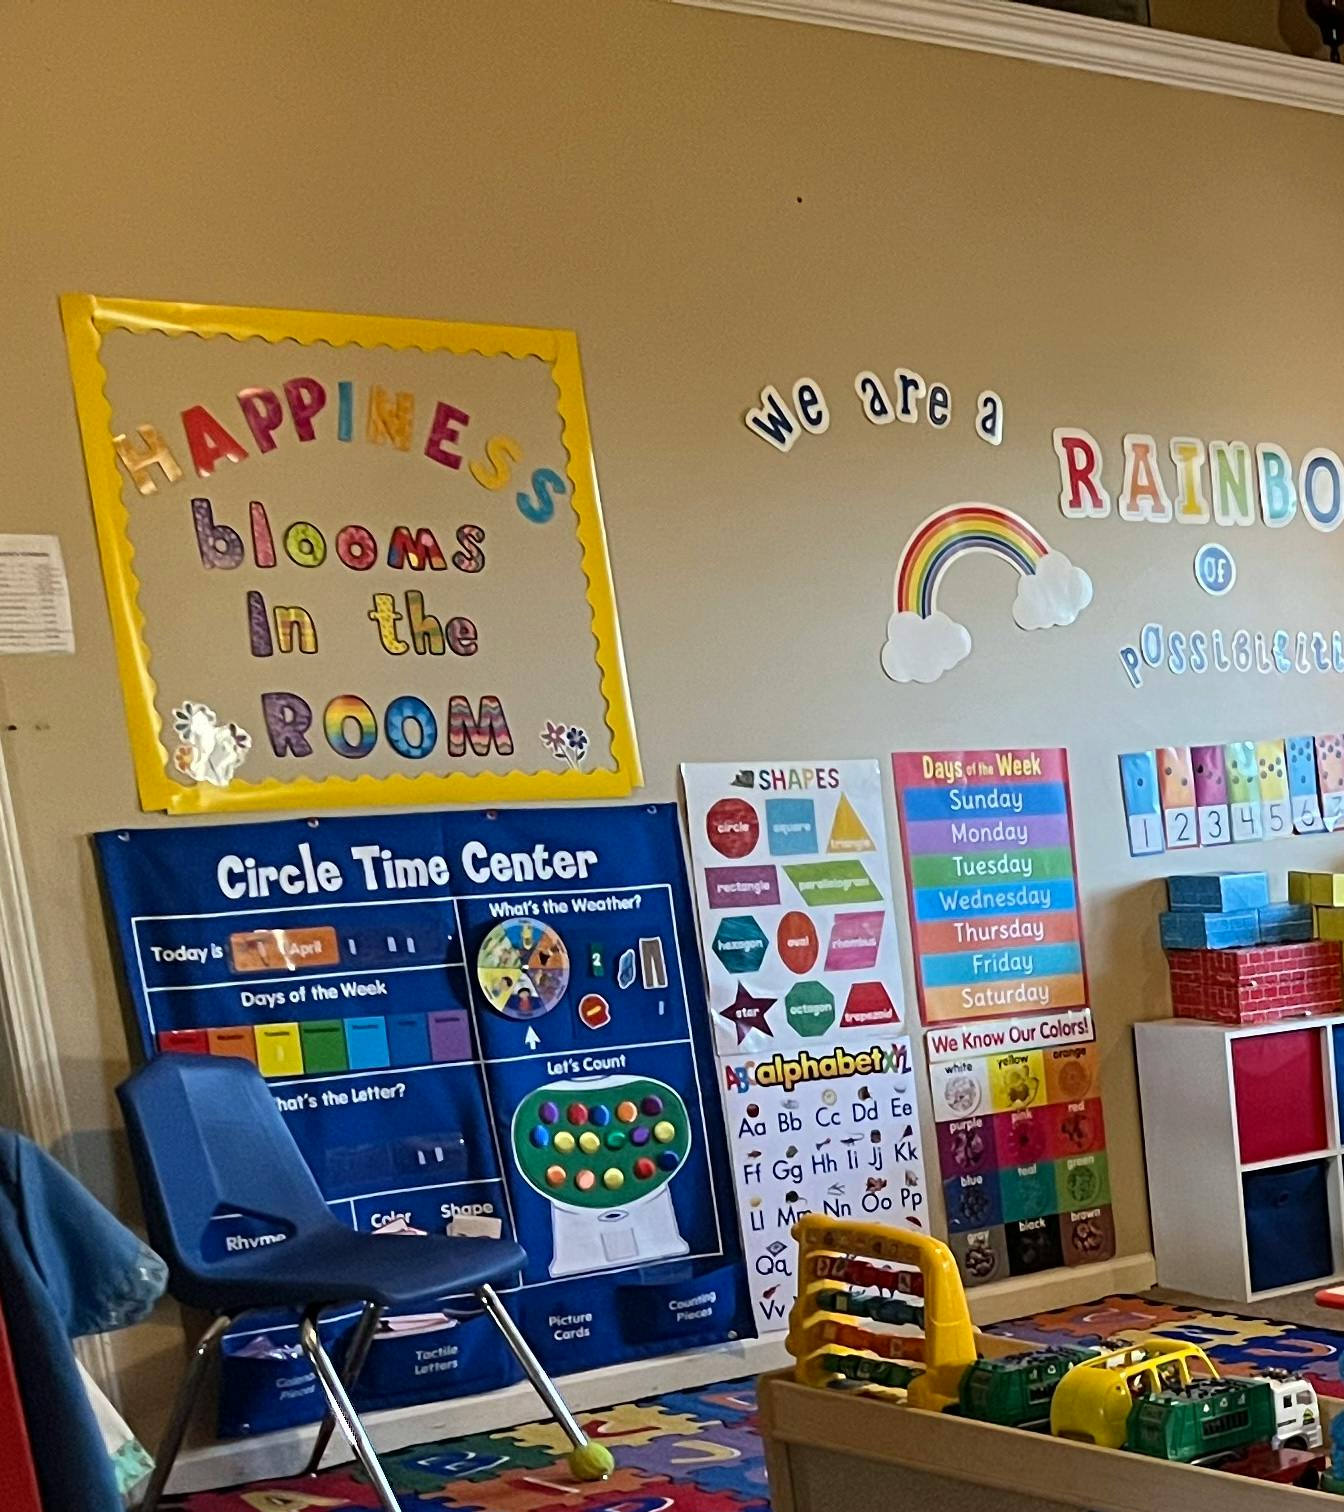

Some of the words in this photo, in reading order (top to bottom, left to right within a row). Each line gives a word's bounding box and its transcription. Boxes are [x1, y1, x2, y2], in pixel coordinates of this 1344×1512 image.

[855, 368, 951, 429] are
[113, 377, 566, 524] HAPPINESS
[191, 498, 486, 573] blooms
[368, 589, 479, 657] the
[261, 692, 514, 759] ROOM
[758, 767, 840, 790] SHAPES
[922, 754, 963, 784] Days
[966, 762, 977, 777] of
[978, 761, 994, 776] the
[996, 751, 1043, 776] Week
[949, 788, 1023, 812] Sunday
[717, 822, 750, 834] circle
[951, 820, 1028, 845] Monday
[1143, 818, 1149, 849] 1
[1174, 812, 1190, 842] 2
[1207, 810, 1222, 838] 3
[1241, 805, 1256, 836] 4
[1269, 803, 1284, 832] 5
[1301, 799, 1315, 827] 6
[217, 844, 344, 899] Circle
[351, 845, 450, 891] Time
[461, 841, 599, 883] Center
[952, 853, 1032, 877] Tuesday
[489, 900, 540, 918] What's
[543, 899, 569, 914] the
[571, 894, 642, 913] Weather?
[938, 886, 1051, 911] Wednesday
[953, 918, 1045, 943] Thursday
[150, 946, 208, 964] Today
[210, 943, 224, 959] is
[592, 953, 602, 967] 2
[972, 952, 1033, 975] Friday
[240, 990, 286, 1009] Days
[289, 985, 308, 1002] of
[311, 984, 339, 1001] the
[341, 980, 388, 998] Week
[961, 983, 1050, 1008] Saturday
[932, 1036, 958, 1054] We
[962, 1032, 1005, 1050] Know
[1009, 1026, 1036, 1042] Our
[1040, 1016, 1088, 1038] Colors!
[547, 1058, 580, 1075] Let's
[583, 1054, 626, 1070] Count
[755, 1046, 884, 1092] alphabet
[945, 1062, 973, 1074] white
[997, 1054, 1029, 1070] yellow
[1053, 1047, 1087, 1060] orange
[274, 1092, 318, 1113] hat's
[322, 1088, 349, 1106] the
[351, 1083, 406, 1103] Letter?
[738, 1117, 767, 1139] Aa
[778, 1111, 802, 1133] Bb
[815, 1106, 842, 1128] Cc
[852, 1100, 878, 1123] Dd
[891, 1097, 912, 1118] Ee
[950, 1118, 982, 1134] purple
[744, 1163, 762, 1185] Ff
[772, 1159, 803, 1184] Gg
[811, 1153, 838, 1175] Hh
[868, 1146, 883, 1171] Jj
[894, 1142, 919, 1163] Kk
[960, 1175, 983, 1187] blue
[1067, 1156, 1095, 1170] green
[440, 1201, 494, 1219] Shape
[750, 1210, 765, 1231] Ll
[823, 1198, 851, 1217] Nn
[861, 1192, 893, 1213] Oo
[900, 1188, 922, 1211] Pp
[1019, 1218, 1046, 1231] black
[1071, 1209, 1101, 1222] brown
[755, 1255, 792, 1277] Qq
[669, 1291, 716, 1311] Counting
[759, 1300, 786, 1320] Vv
[549, 1313, 592, 1327] Picture
[677, 1307, 713, 1322] Pieces
[554, 1327, 590, 1341] Cards
[415, 1344, 458, 1361] Tactile
[414, 1360, 458, 1375] Letters
